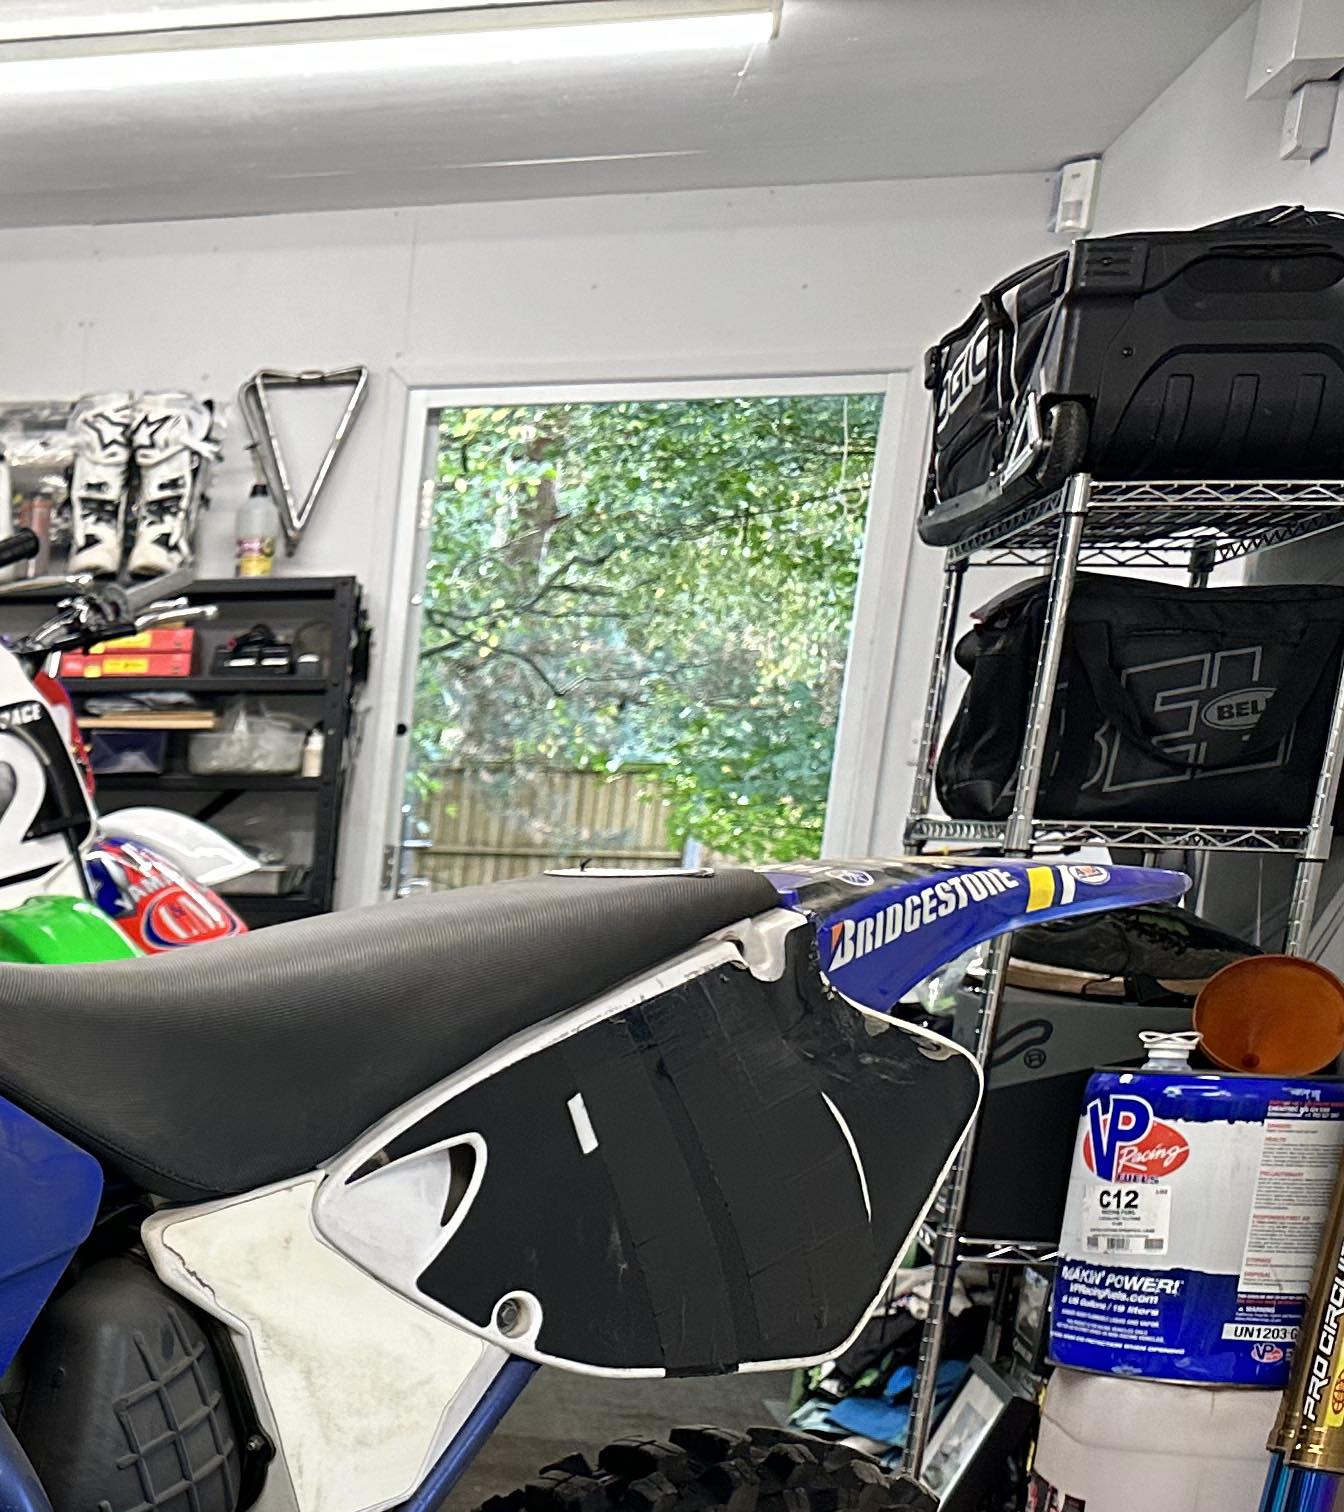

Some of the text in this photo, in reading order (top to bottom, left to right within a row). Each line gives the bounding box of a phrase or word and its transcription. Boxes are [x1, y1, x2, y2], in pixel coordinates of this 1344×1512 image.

[1215, 699, 1264, 722] BEL
[827, 868, 1020, 973] BRIDGESTONE
[1088, 1094, 1154, 1184] VP
[1117, 1143, 1190, 1172] Racing
[1099, 1190, 1140, 1210] C12
[1105, 1272, 1182, 1296] POWER!
[1233, 1326, 1288, 1341] UN1203
[1303, 1358, 1330, 1423] PRO
